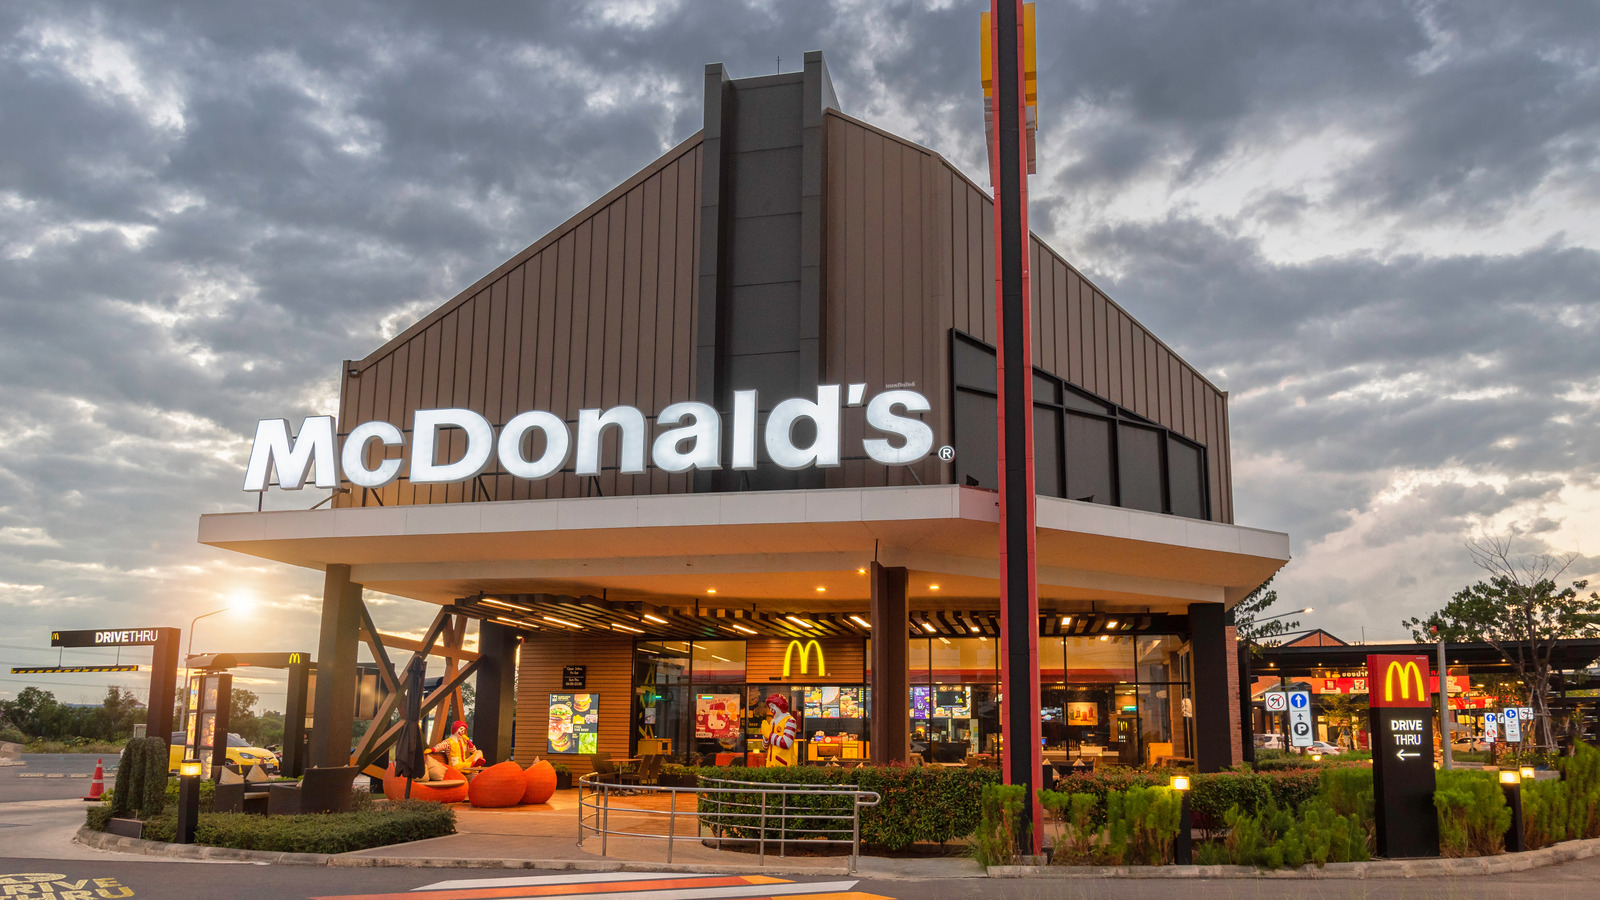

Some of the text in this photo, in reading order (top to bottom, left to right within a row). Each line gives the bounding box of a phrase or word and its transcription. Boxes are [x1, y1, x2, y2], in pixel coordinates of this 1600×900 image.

[243, 383, 935, 492] McDonald's
[1391, 720, 1423, 731] DRIVE
[1394, 734, 1421, 746] THRU
[3, 877, 122, 896] RIVE
